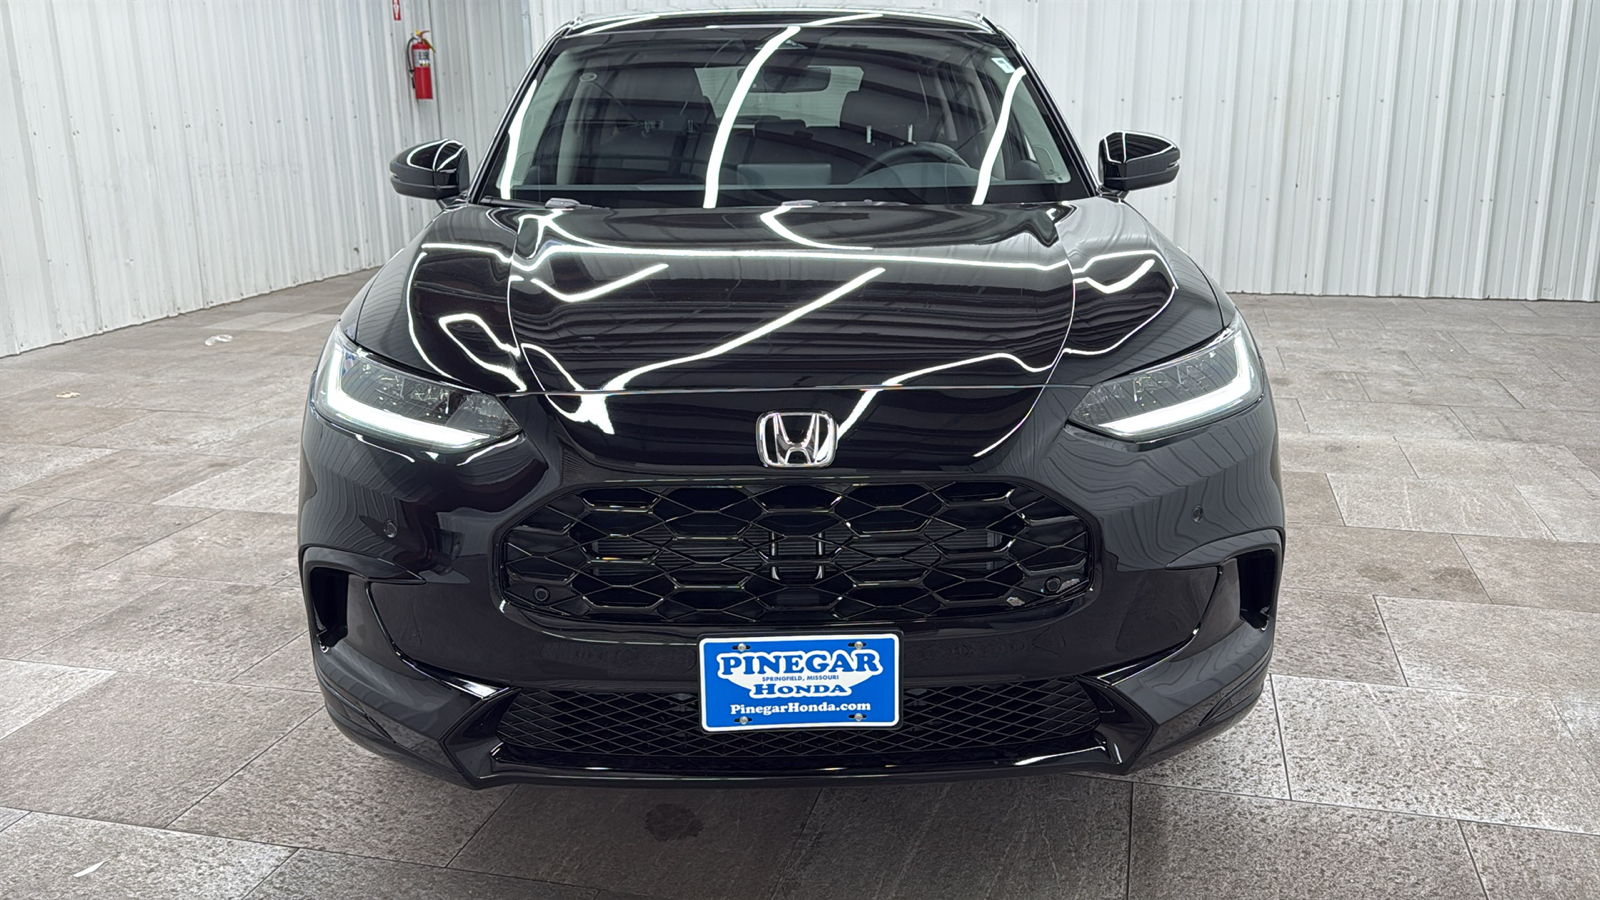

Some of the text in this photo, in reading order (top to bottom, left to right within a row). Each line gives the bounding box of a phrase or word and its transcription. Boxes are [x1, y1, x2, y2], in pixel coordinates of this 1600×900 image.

[721, 653, 879, 675] PINEGAR
[753, 683, 847, 695] HONDA
[730, 701, 871, 715] PinegarHonda.com
